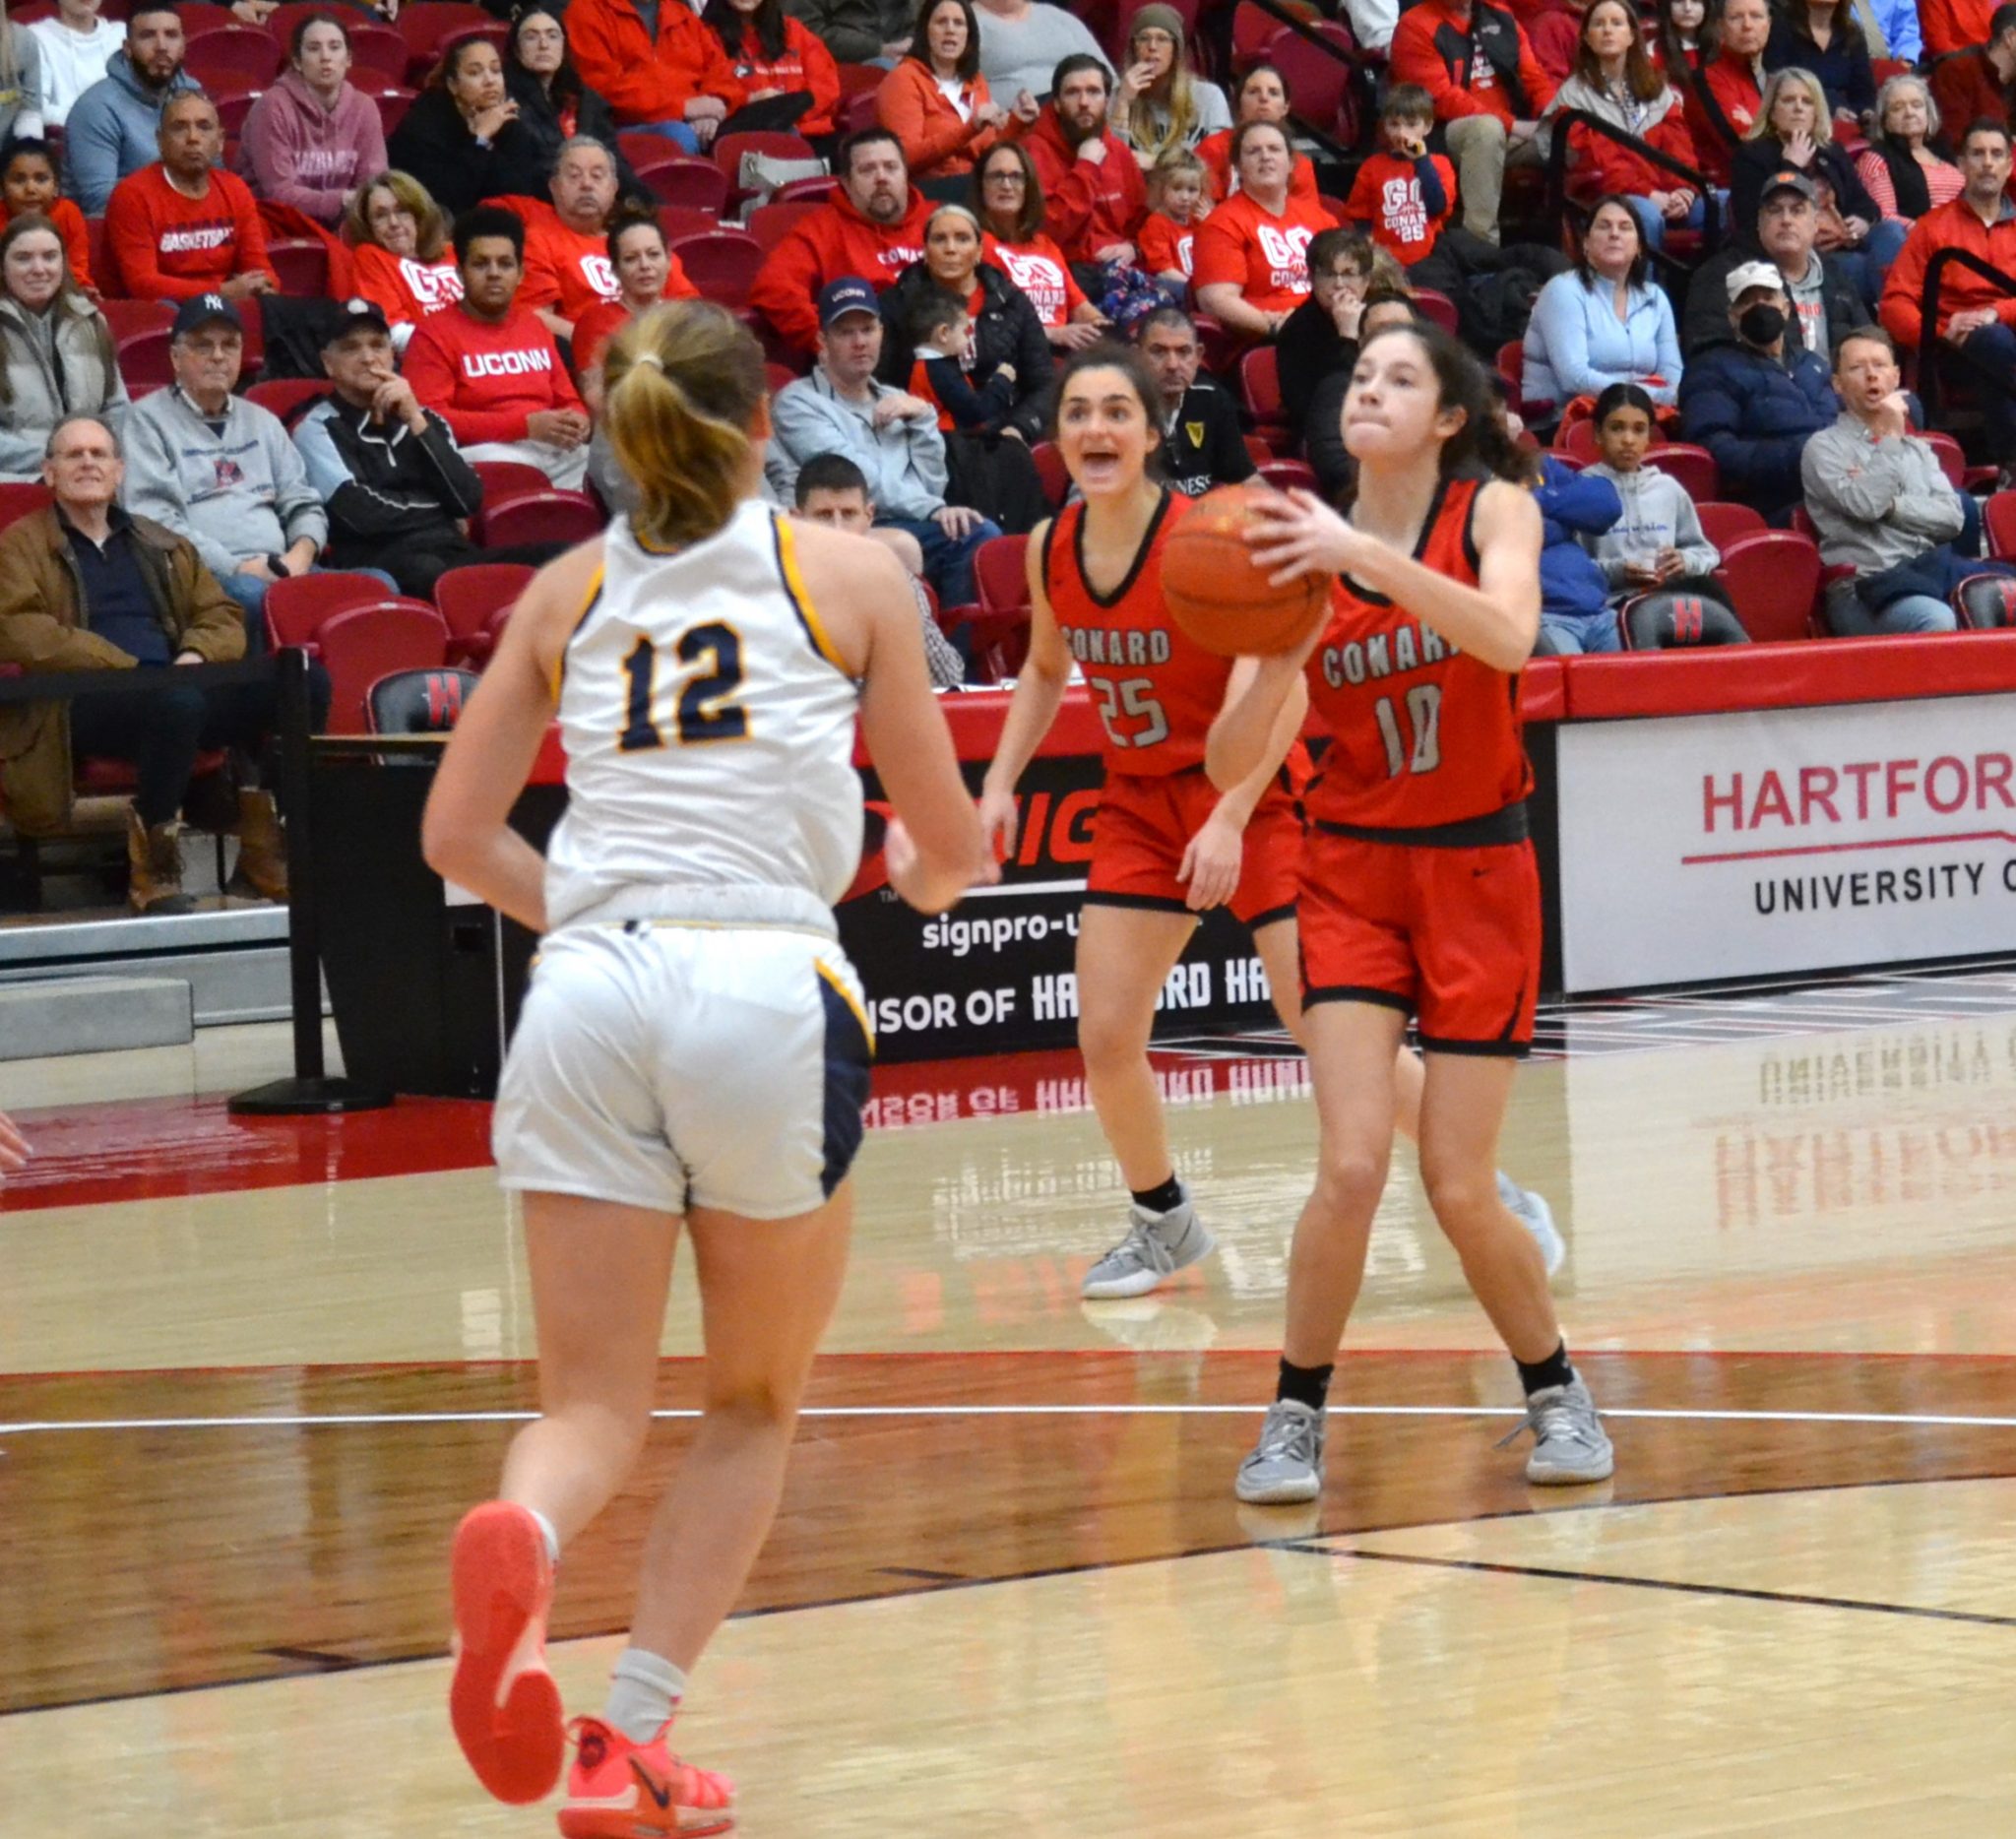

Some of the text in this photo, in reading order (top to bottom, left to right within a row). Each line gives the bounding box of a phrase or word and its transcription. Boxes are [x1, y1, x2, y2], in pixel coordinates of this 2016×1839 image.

[463, 348, 552, 378] UCONN
[617, 619, 754, 755] 12
[1322, 620, 1460, 689] CONAR
[1089, 676, 1169, 748] 25
[1375, 683, 1442, 778] 10
[1755, 861, 1984, 916] UNIVERSITY
[966, 987, 1016, 1026] OF
